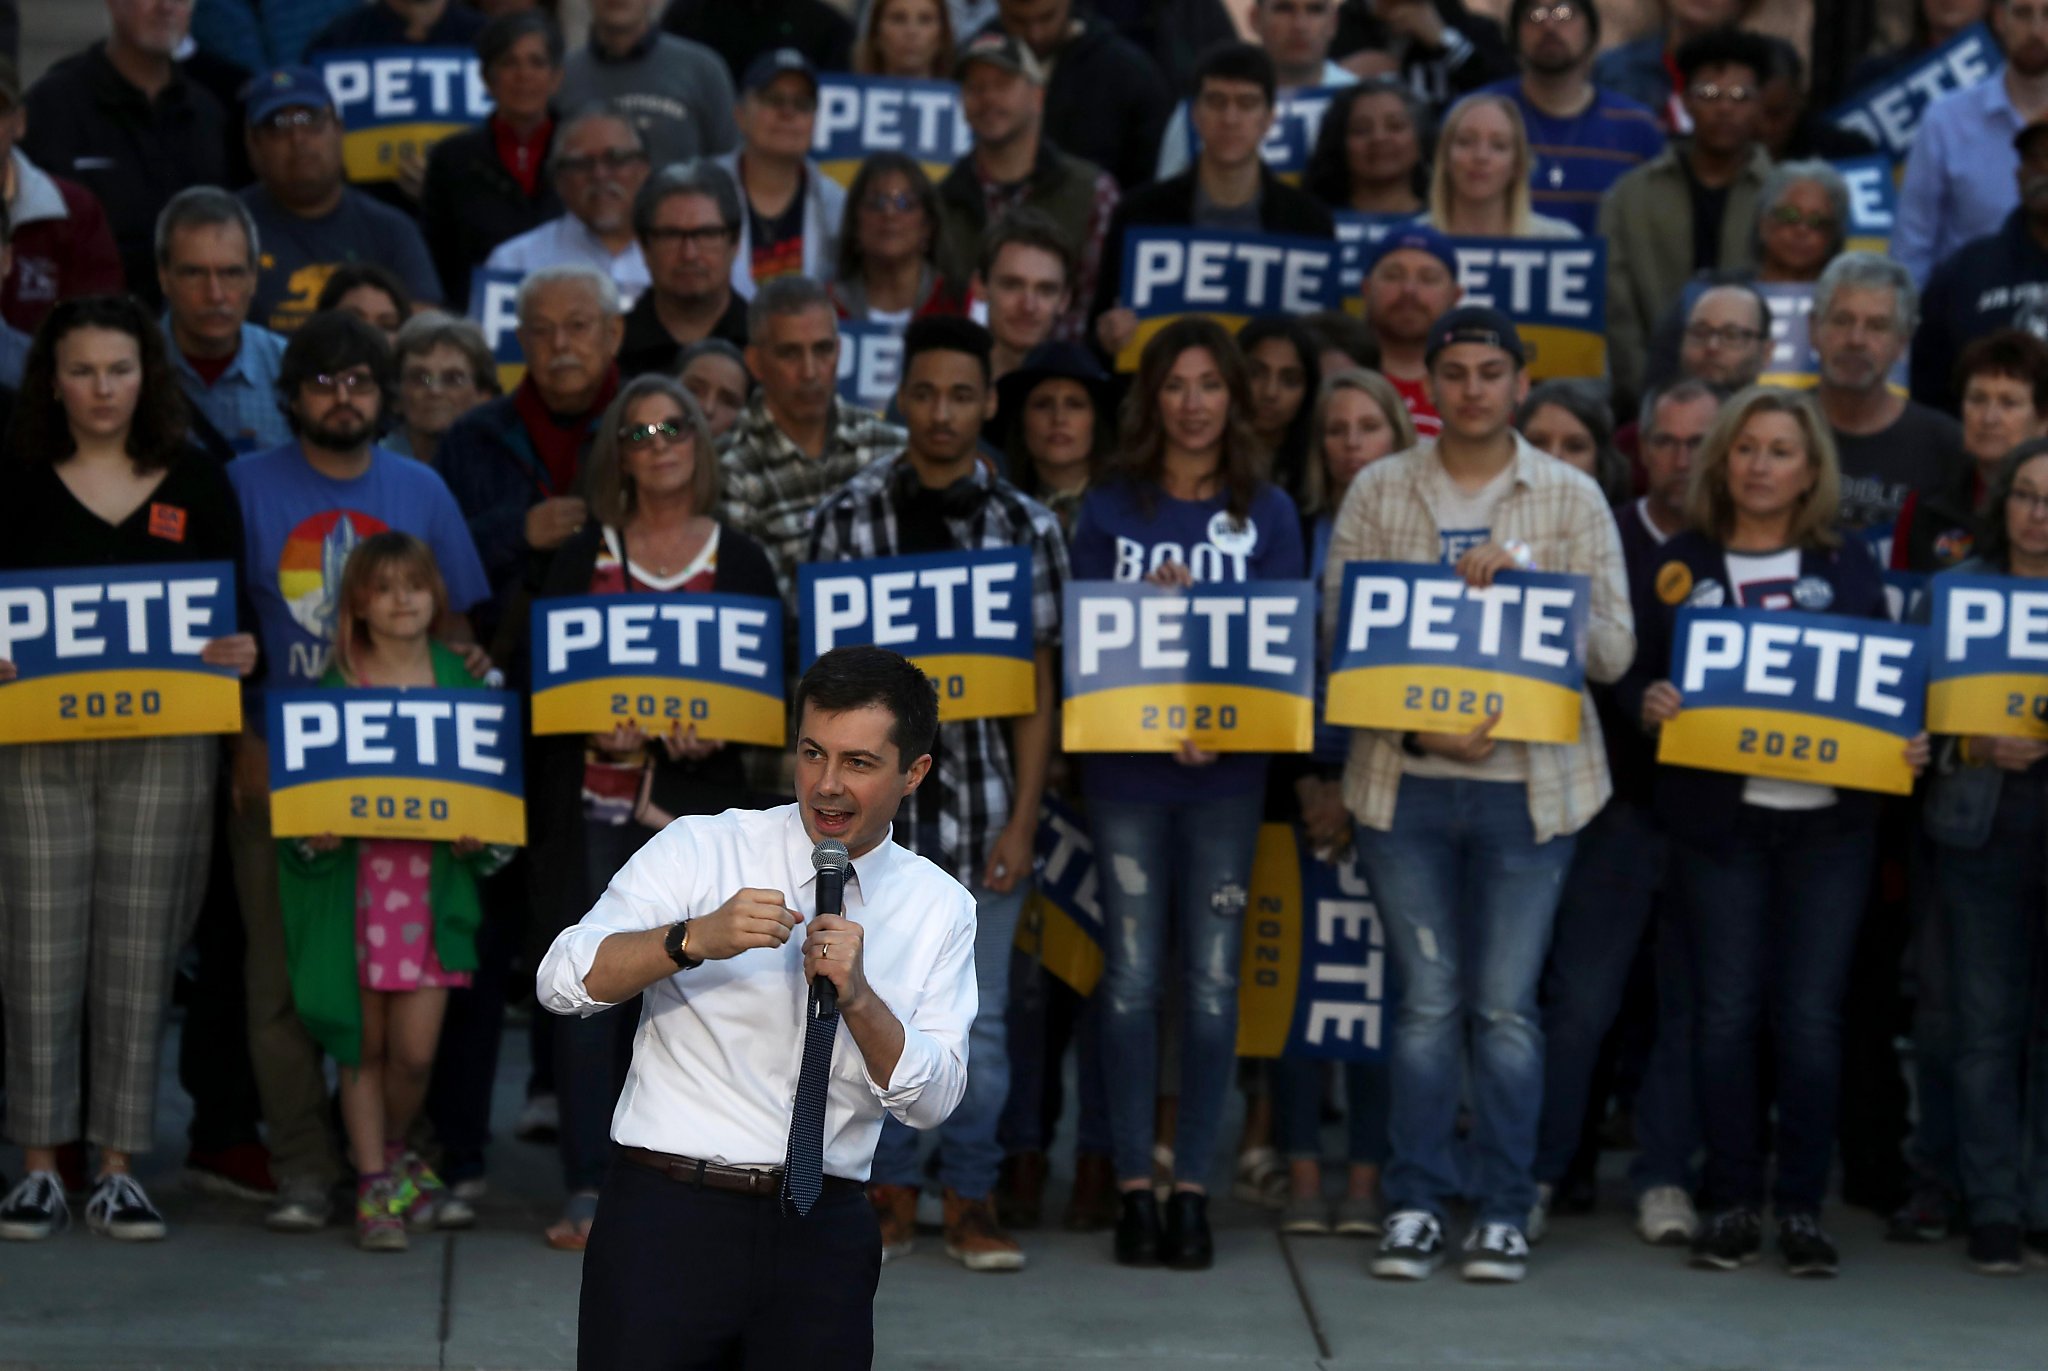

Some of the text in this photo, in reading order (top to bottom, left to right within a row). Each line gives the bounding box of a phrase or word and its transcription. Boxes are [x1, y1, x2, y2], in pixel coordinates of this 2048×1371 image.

[1132, 240, 1331, 315] PETE
[1454, 248, 1595, 318] ETE
[0, 578, 219, 662] PETE
[547, 604, 768, 677] PETE
[813, 562, 1018, 656] PETE
[1079, 597, 1299, 675] PETE
[1348, 576, 1575, 667] PETE
[1947, 588, 2048, 662] PE
[59, 690, 161, 719] 2020
[1404, 686, 1504, 716] 2020
[1682, 619, 1914, 717] PETE
[282, 701, 505, 775] PETE
[611, 695, 708, 719] 2020
[1142, 705, 1237, 729] 2020
[1739, 729, 1839, 762] 2020
[351, 796, 449, 820] 2020
[1256, 896, 1282, 988] 2020
